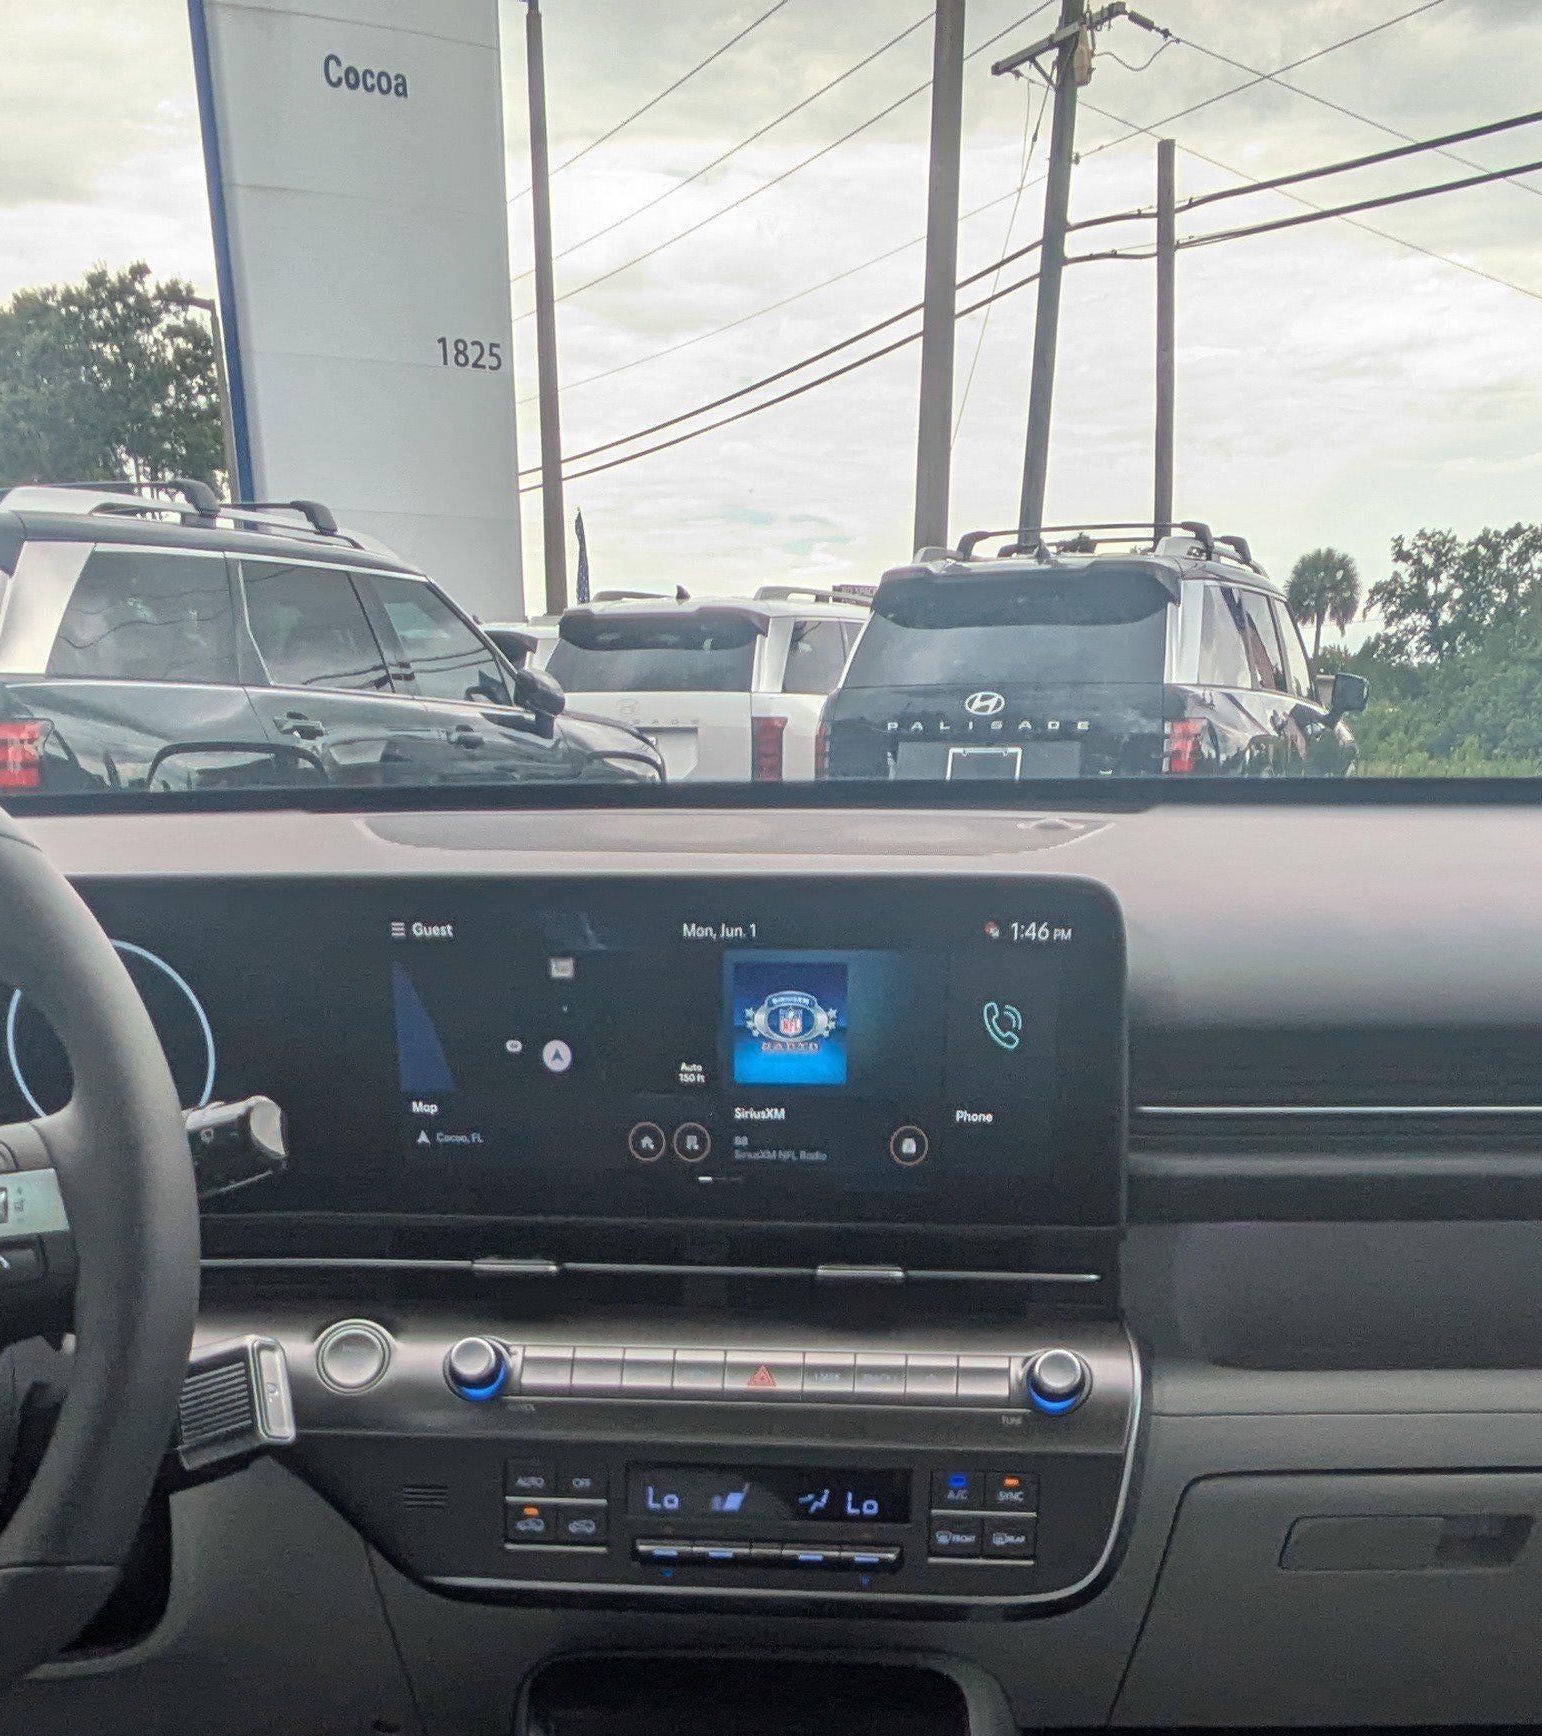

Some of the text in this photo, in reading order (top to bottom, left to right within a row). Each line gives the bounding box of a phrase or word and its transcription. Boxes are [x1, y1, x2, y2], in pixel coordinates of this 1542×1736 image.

[323, 54, 408, 98] Cocoa
[436, 336, 503, 371] 1825
[887, 720, 1090, 731] PALISADE
[412, 922, 454, 938] Guest
[682, 923, 757, 940] Mon, Jun. 1
[1011, 921, 1073, 941] 1:46 PM
[783, 1019, 801, 1032] NFL
[680, 1062, 702, 1072] Auto
[411, 1100, 439, 1115] Map
[734, 1107, 786, 1121] SiriusXM
[955, 1109, 994, 1124] Phone
[515, 1476, 545, 1489] AUTO
[645, 1485, 681, 1511] Lo
[946, 1489, 968, 1501] A/C
[997, 1490, 1025, 1502] SYNC
[845, 1491, 880, 1517] Lo
